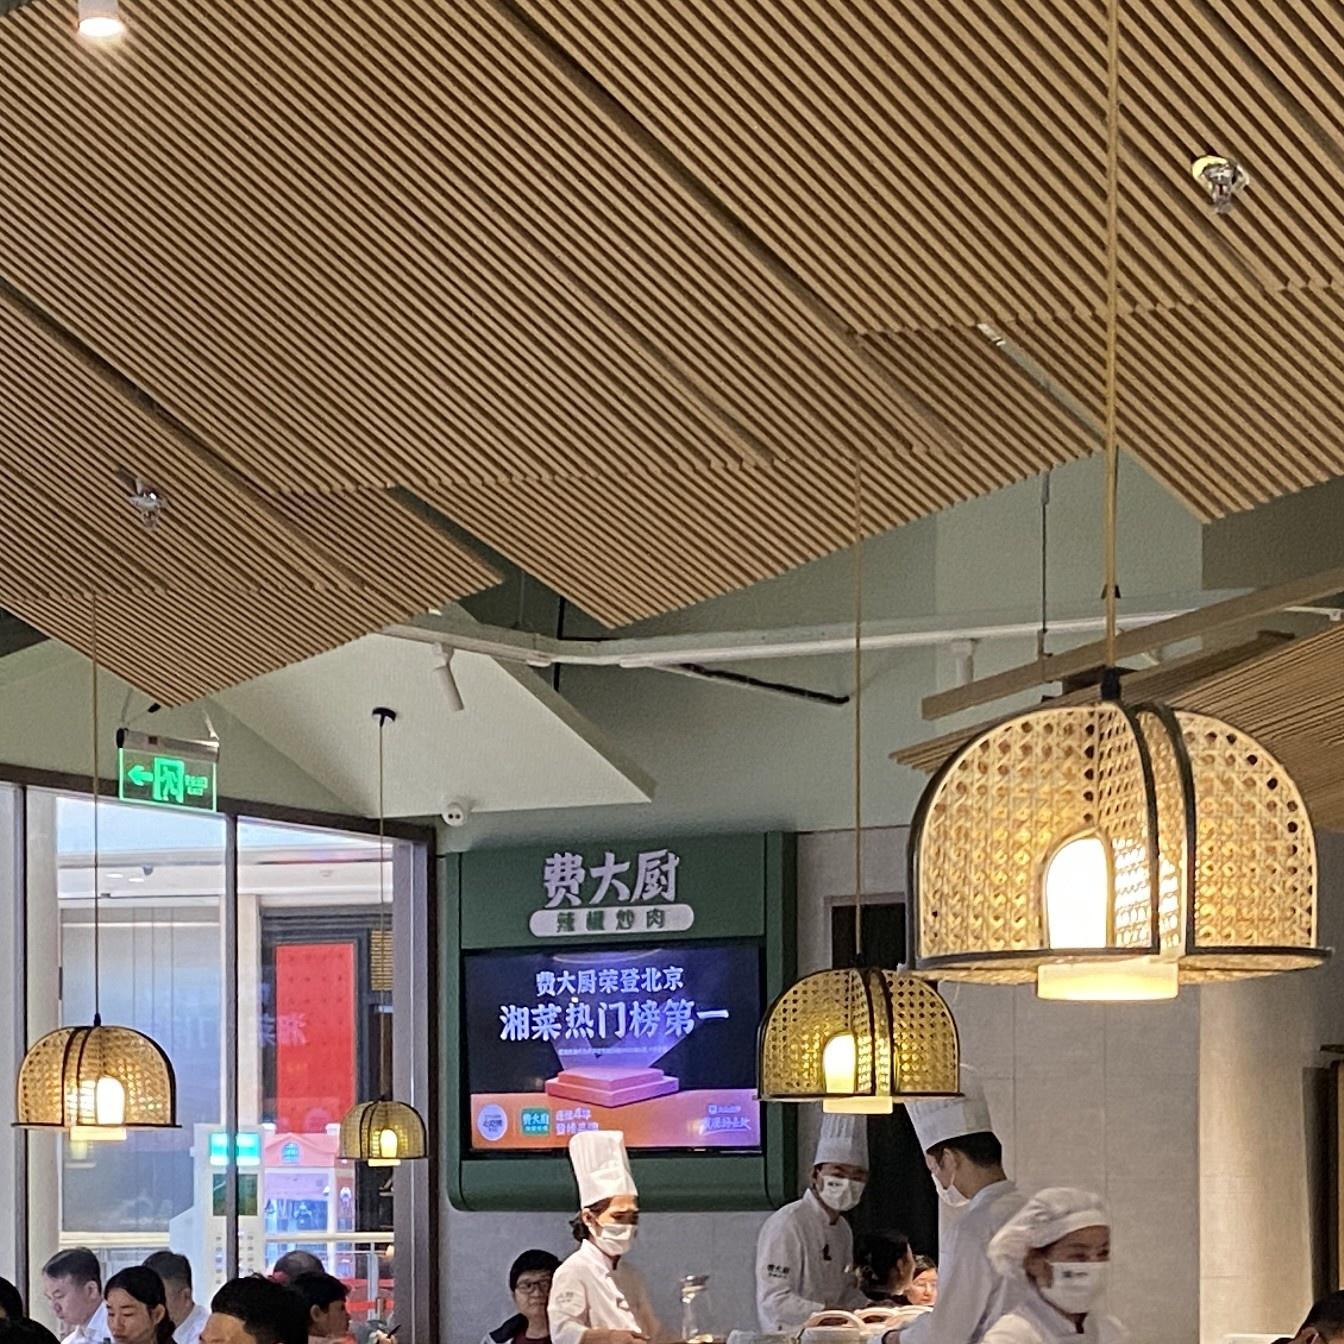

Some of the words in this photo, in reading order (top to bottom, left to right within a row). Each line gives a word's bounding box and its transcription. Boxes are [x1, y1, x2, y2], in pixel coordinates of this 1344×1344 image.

[543, 849, 680, 908] 费大厨
[536, 966, 684, 997] 费大厨荣登北京
[499, 998, 730, 1041] 湘菜热门榜第一
